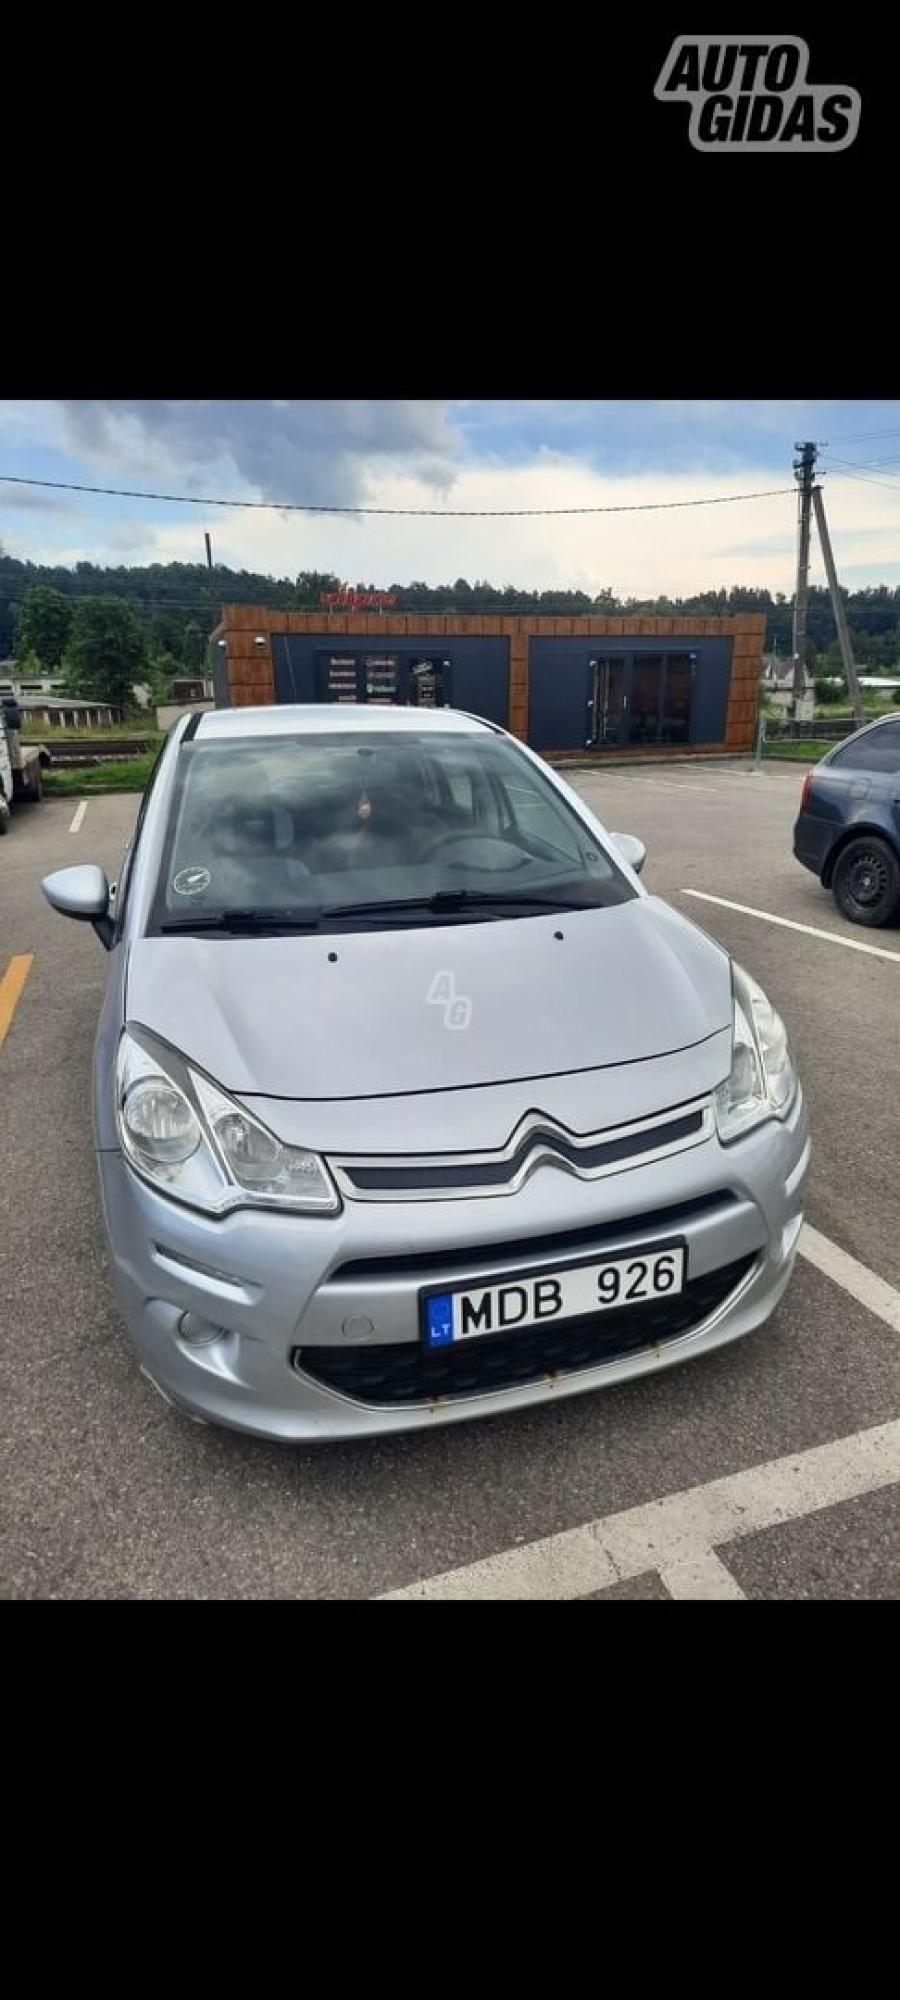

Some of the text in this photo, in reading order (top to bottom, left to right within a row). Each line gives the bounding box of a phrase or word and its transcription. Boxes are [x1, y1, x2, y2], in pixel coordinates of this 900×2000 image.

[460, 1256, 675, 1335] MDB 926
[431, 1324, 450, 1338] LT
